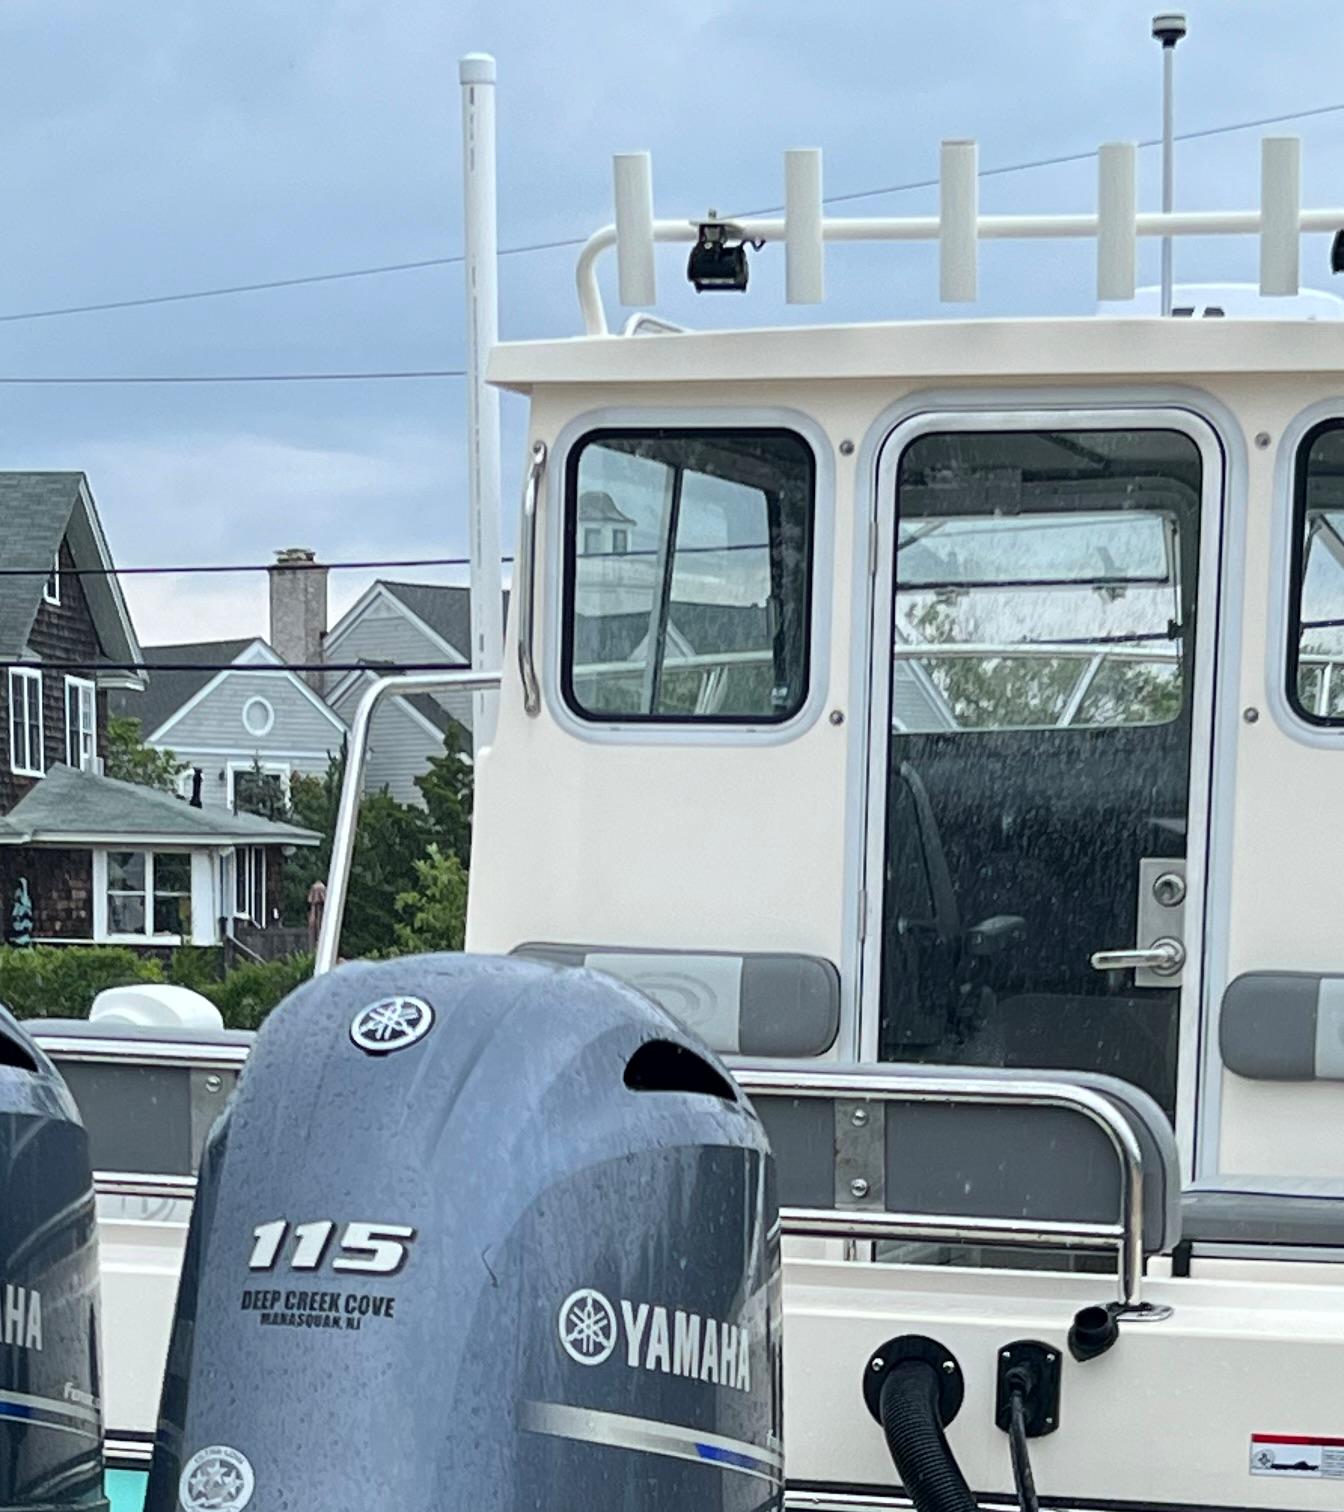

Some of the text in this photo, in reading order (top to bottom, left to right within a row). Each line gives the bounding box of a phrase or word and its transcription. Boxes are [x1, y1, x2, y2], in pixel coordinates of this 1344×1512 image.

[248, 1219, 418, 1277] 115
[241, 1289, 396, 1318] DEEP CREEK COVE
[346, 1316, 362, 1331] NJ
[620, 1299, 751, 1393] YAMAHA
